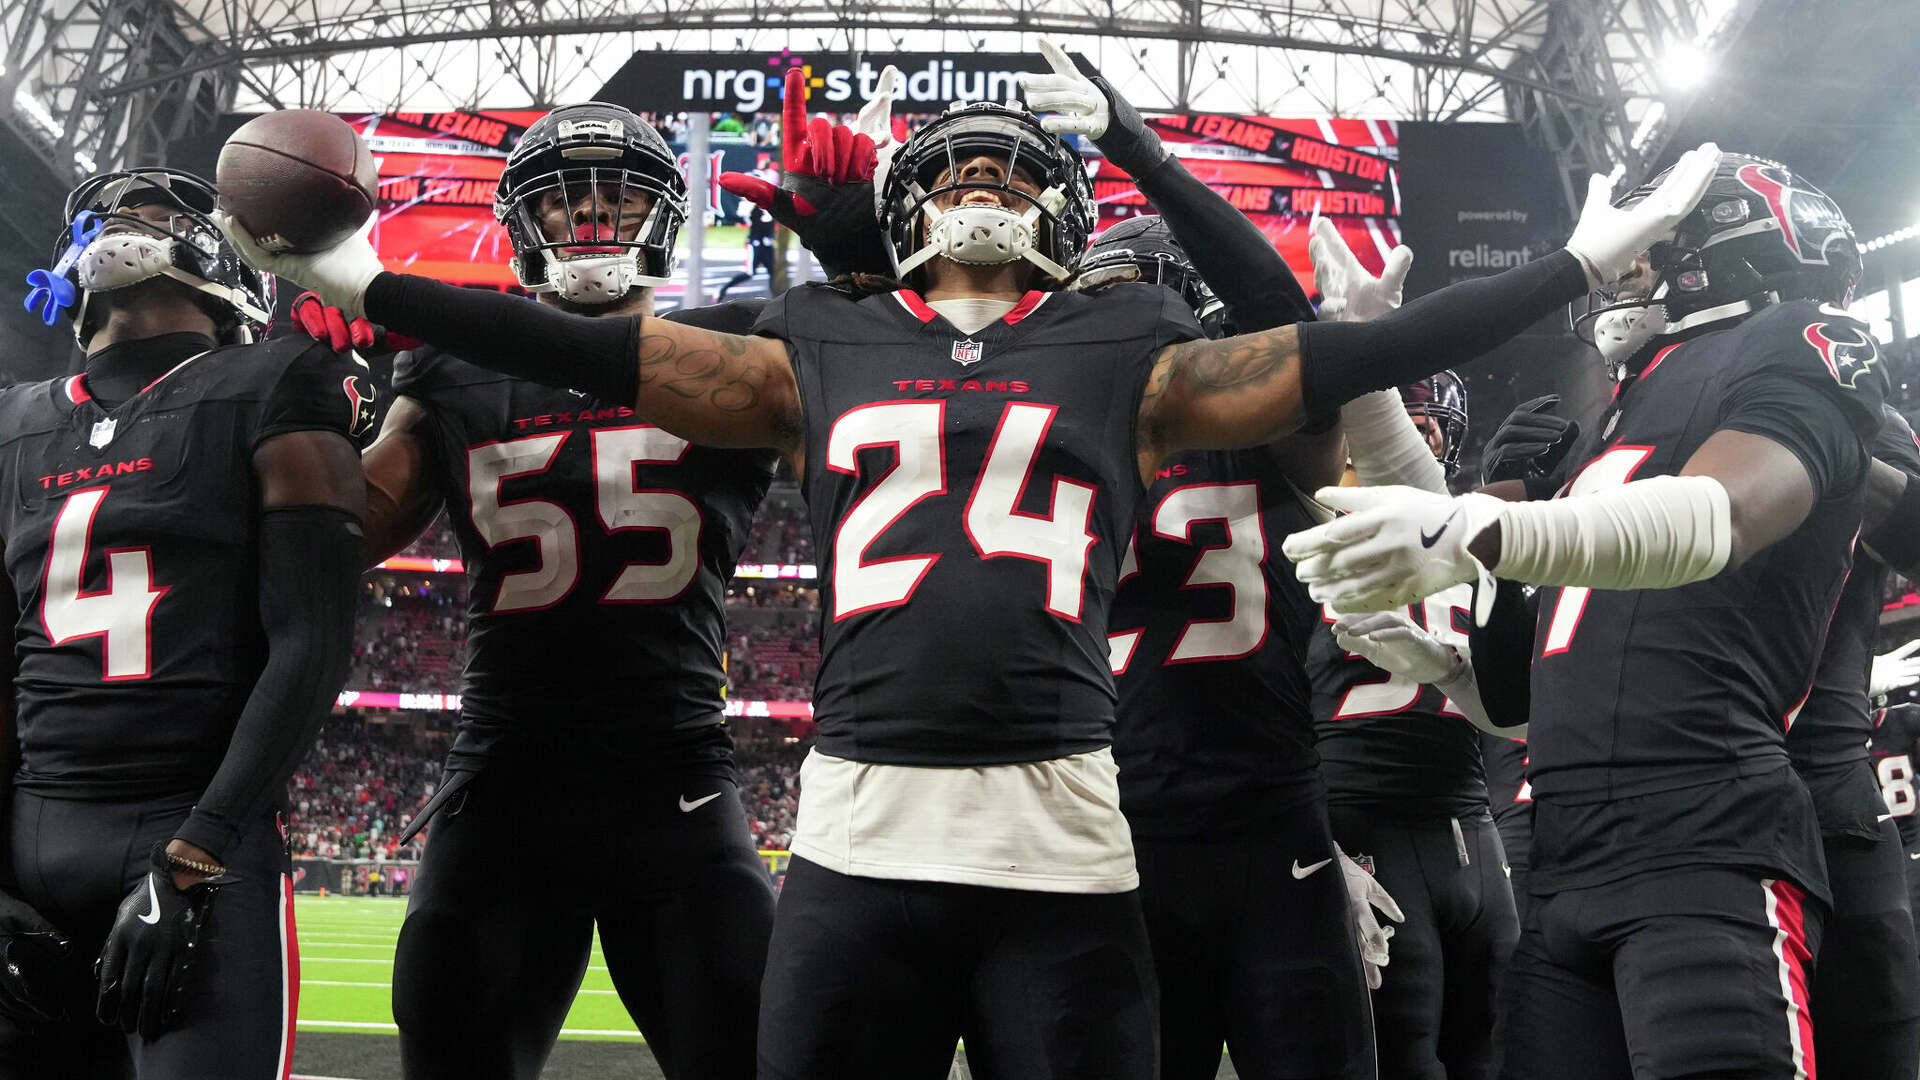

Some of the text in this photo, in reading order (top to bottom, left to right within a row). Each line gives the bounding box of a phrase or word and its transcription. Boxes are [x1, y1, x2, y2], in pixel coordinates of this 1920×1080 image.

[683, 69, 766, 113] nrg
[428, 112, 508, 146] TEXANS
[1192, 115, 1388, 182] TEXANS HOUSTON
[424, 179, 498, 205] TEXANS
[1291, 188, 1385, 216] HOUSTON
[1513, 209, 1528, 223] by
[1449, 244, 1533, 268] reliant
[956, 348, 977, 360] NFL
[893, 378, 1030, 393] TEXANS
[513, 406, 635, 430] TEXANS
[39, 457, 153, 489] TEXANS
[465, 423, 705, 615] 55
[826, 399, 1101, 624] 24
[40, 485, 173, 681] 4
